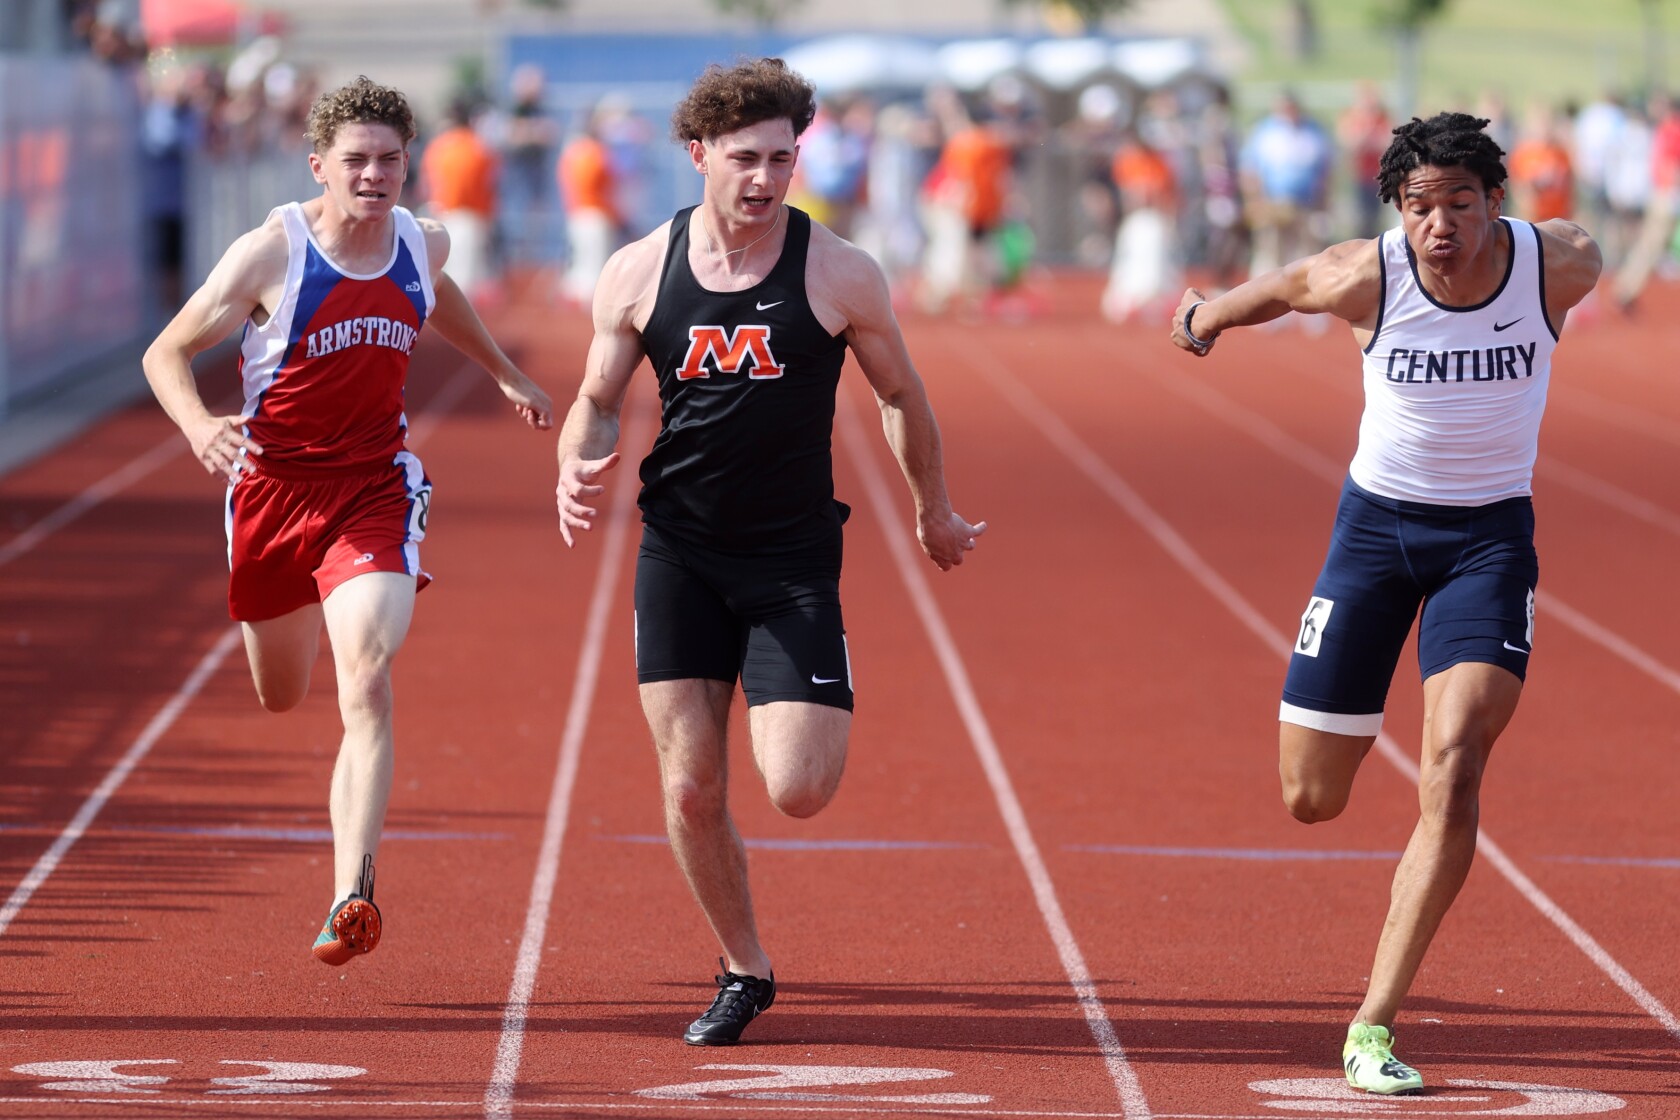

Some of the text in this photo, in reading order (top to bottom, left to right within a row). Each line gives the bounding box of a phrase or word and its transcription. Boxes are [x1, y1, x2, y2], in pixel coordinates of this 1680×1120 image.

[676, 325, 785, 381] M
[1386, 341, 1537, 384] CENTURY
[1300, 600, 1324, 651] 6
